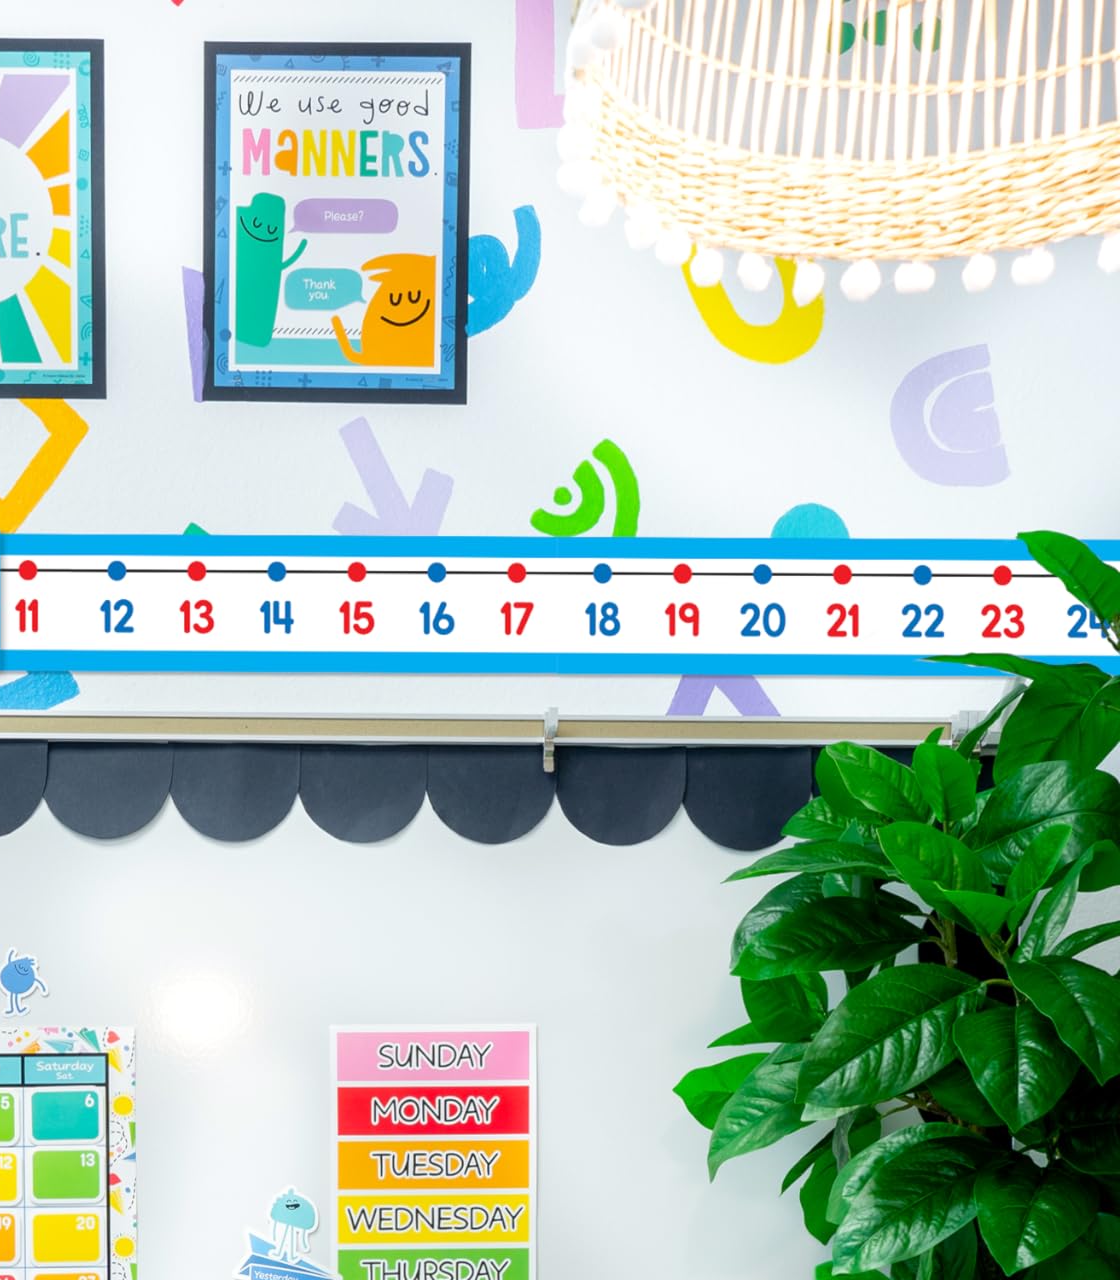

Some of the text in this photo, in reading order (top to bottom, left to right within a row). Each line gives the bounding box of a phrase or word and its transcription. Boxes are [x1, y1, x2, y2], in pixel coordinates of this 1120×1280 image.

[238, 89, 430, 125] We use good
[323, 210, 364, 223] Please?
[302, 278, 336, 290] Thank
[15, 598, 39, 633] 11
[100, 598, 134, 634] 12
[179, 599, 215, 635] 13
[260, 600, 294, 634] 14
[338, 600, 375, 635] 15
[419, 601, 455, 635] 16
[500, 601, 535, 636] 17
[585, 602, 621, 637] 18
[664, 602, 700, 637] 19
[740, 602, 786, 638] 20
[826, 603, 860, 638] 21
[901, 603, 945, 638] 22
[981, 603, 1025, 639] 23
[377, 1043, 491, 1069] SUNDAY
[35, 1061, 94, 1074] Saturday
[0, 1096, 10, 1110] 5
[84, 1094, 95, 1108] 6
[371, 1097, 498, 1124] MONDAY
[80, 1153, 95, 1167] 13
[371, 1152, 500, 1178] TUESDAY
[75, 1217, 96, 1231] 20
[345, 1206, 524, 1232] WEDNESDAY
